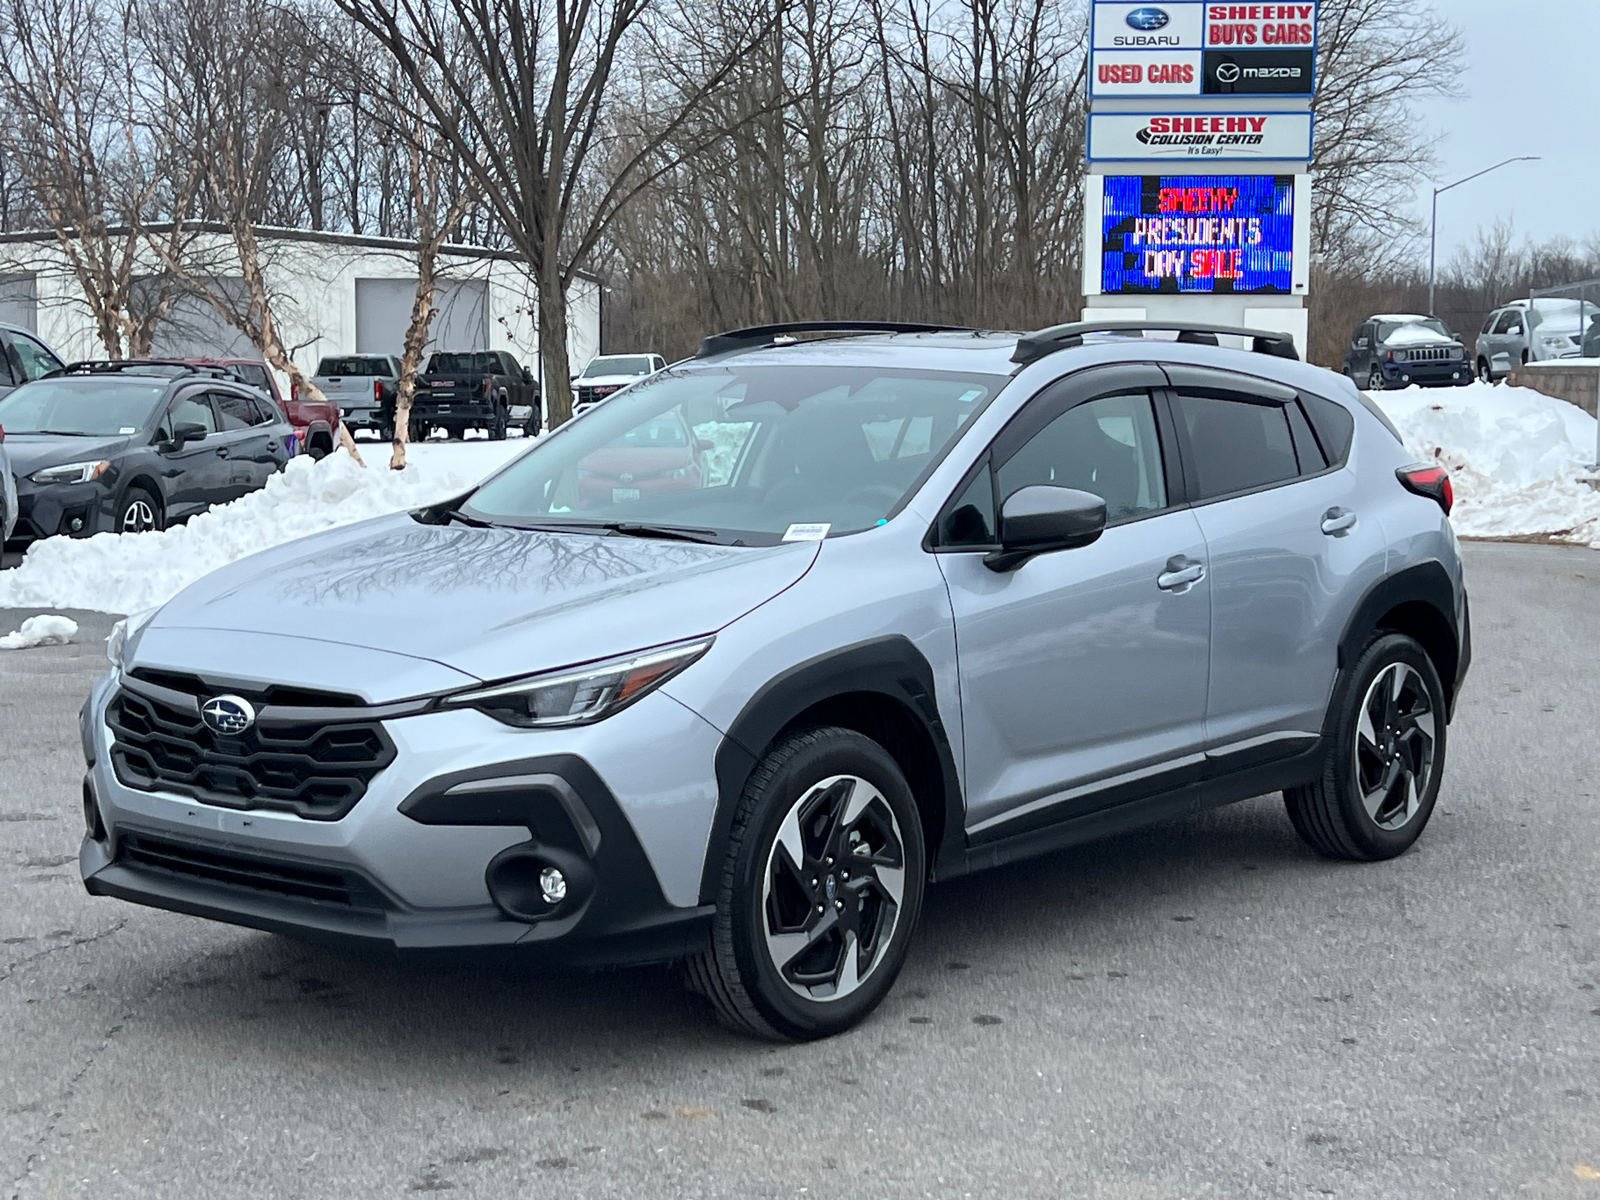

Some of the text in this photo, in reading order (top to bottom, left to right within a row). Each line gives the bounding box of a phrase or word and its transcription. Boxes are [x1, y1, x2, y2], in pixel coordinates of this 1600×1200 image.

[1209, 6, 1312, 20] SHEEHY
[1113, 36, 1180, 46] SUBARU
[1209, 23, 1312, 45] BUYS CARS
[1098, 64, 1194, 84] USED CARS
[1149, 117, 1267, 133] SHEEHY
[1149, 134, 1264, 145] COLLISION CENTER
[1187, 146, 1224, 156] It's Easy!
